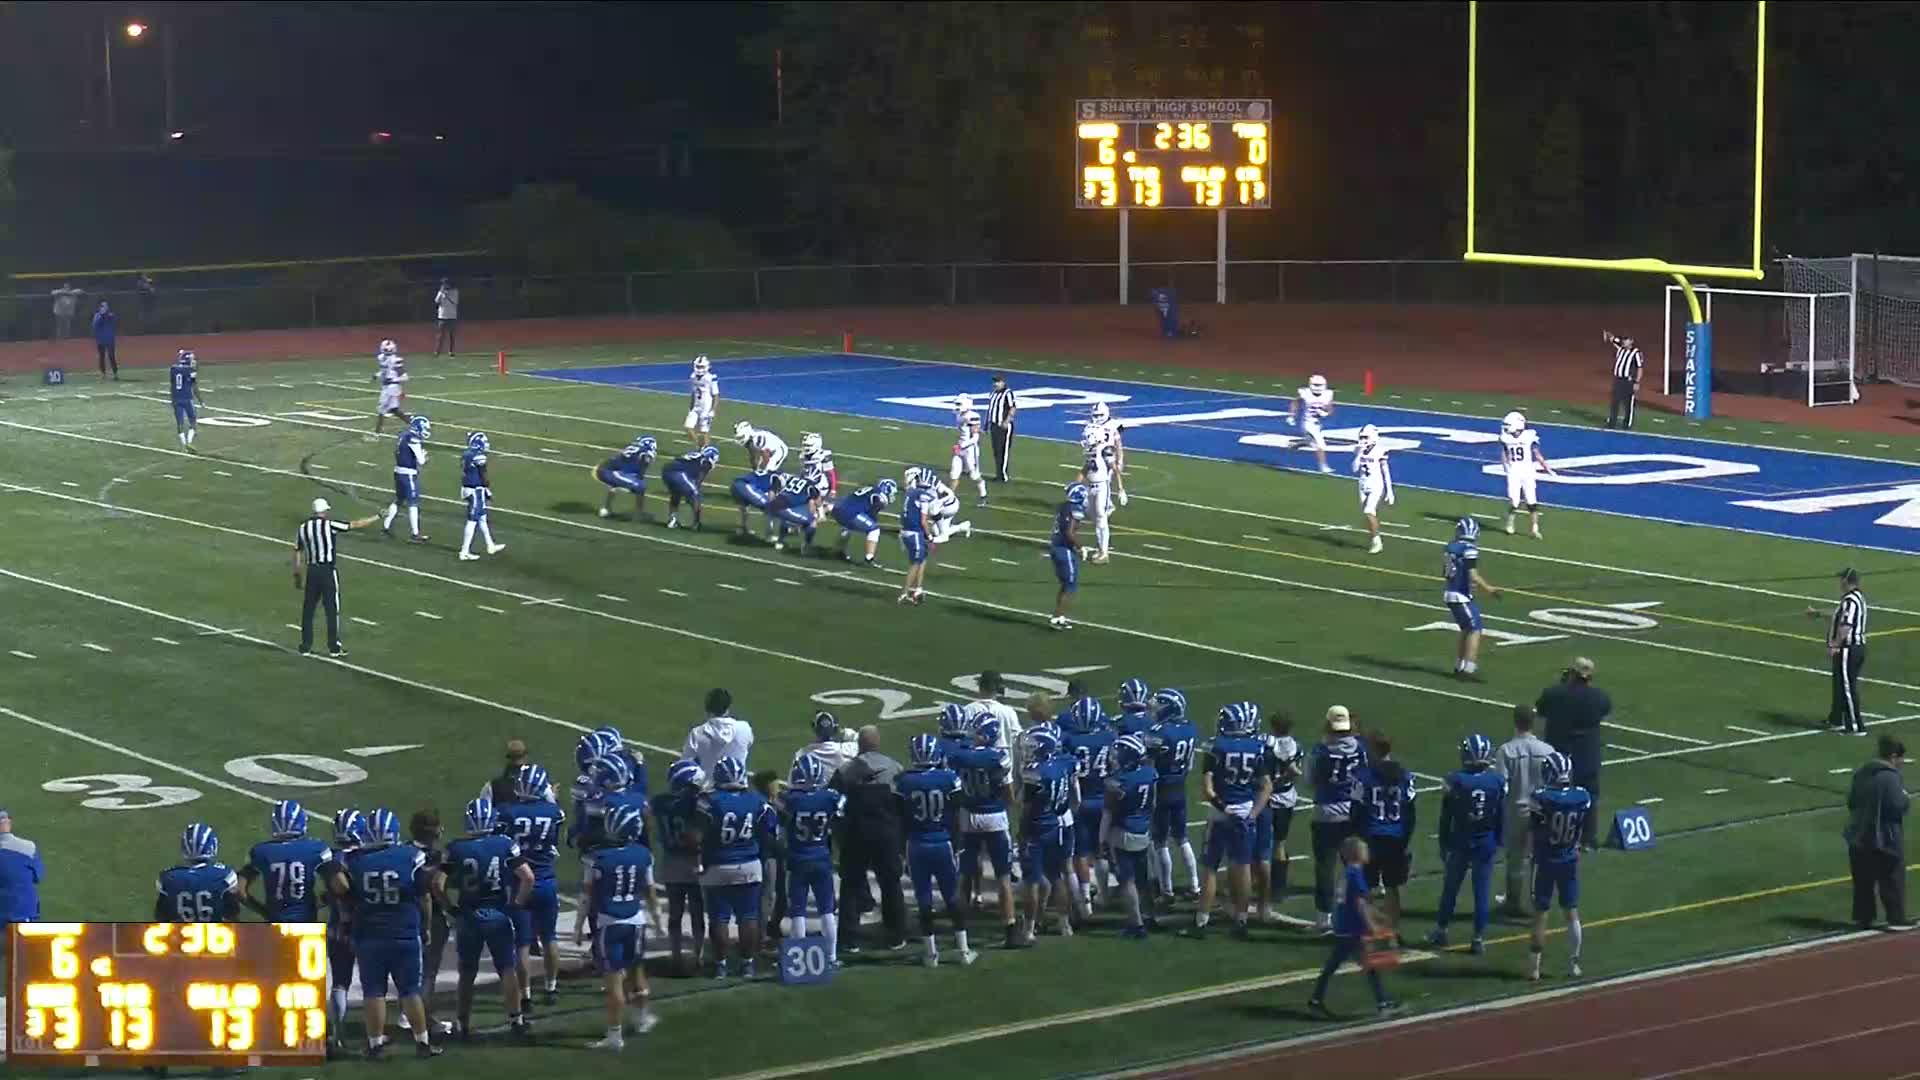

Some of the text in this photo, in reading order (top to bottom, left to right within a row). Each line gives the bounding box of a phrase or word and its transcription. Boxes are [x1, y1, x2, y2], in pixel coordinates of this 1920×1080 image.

[1100, 101, 1242, 113] SHAKER HIGH SCHOOL
[1099, 138, 1116, 165] 6
[1248, 138, 1267, 165] 0
[1685, 330, 1696, 413] SHAKER
[1510, 446, 1525, 462] 19
[785, 476, 808, 495] 59
[1076, 745, 1109, 778] 34
[1225, 752, 1257, 785] 55
[41, 753, 369, 811] 30
[1137, 784, 1149, 809] 7
[911, 789, 945, 822] 30
[513, 817, 552, 843] 27
[720, 812, 753, 843] 64
[1622, 815, 1650, 844] 20
[270, 861, 305, 900] 78
[363, 870, 399, 905] 56
[463, 856, 501, 891] 24
[614, 864, 637, 902] 11
[786, 944, 825, 977] 30
